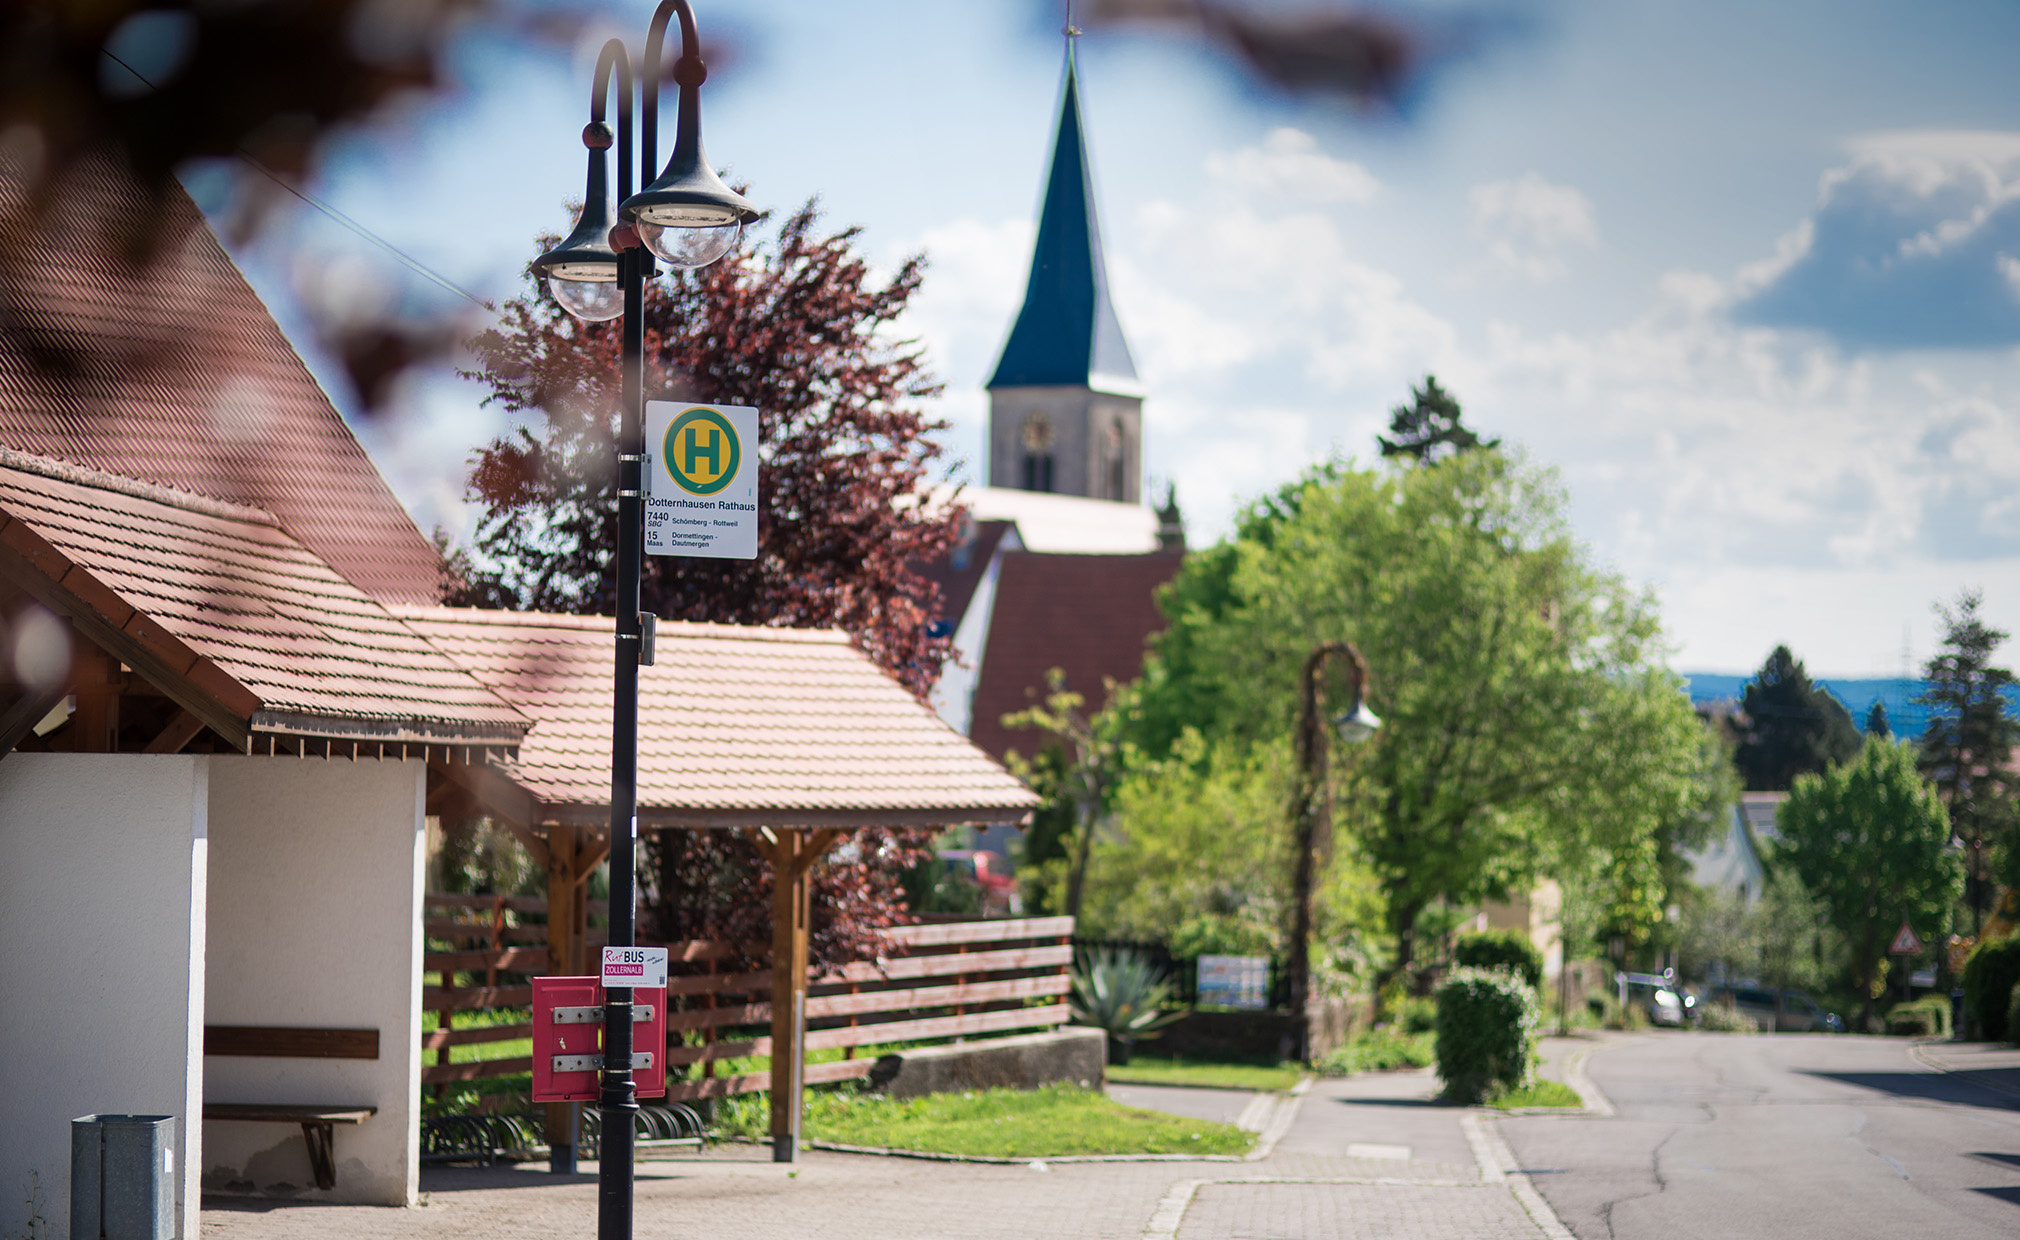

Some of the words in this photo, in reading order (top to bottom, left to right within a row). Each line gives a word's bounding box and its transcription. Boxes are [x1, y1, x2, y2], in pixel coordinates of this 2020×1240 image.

[685, 428, 720, 475] H
[648, 498, 715, 509] Dotternhausen
[718, 501, 756, 511] Rathaus
[647, 512, 669, 521] 7440
[672, 518, 708, 527] Schömberg
[647, 531, 658, 540] 15
[672, 532, 713, 541] Dormettingen
[672, 540, 710, 548] Dautmergen
[605, 966, 643, 974] ZOLLERNALB
